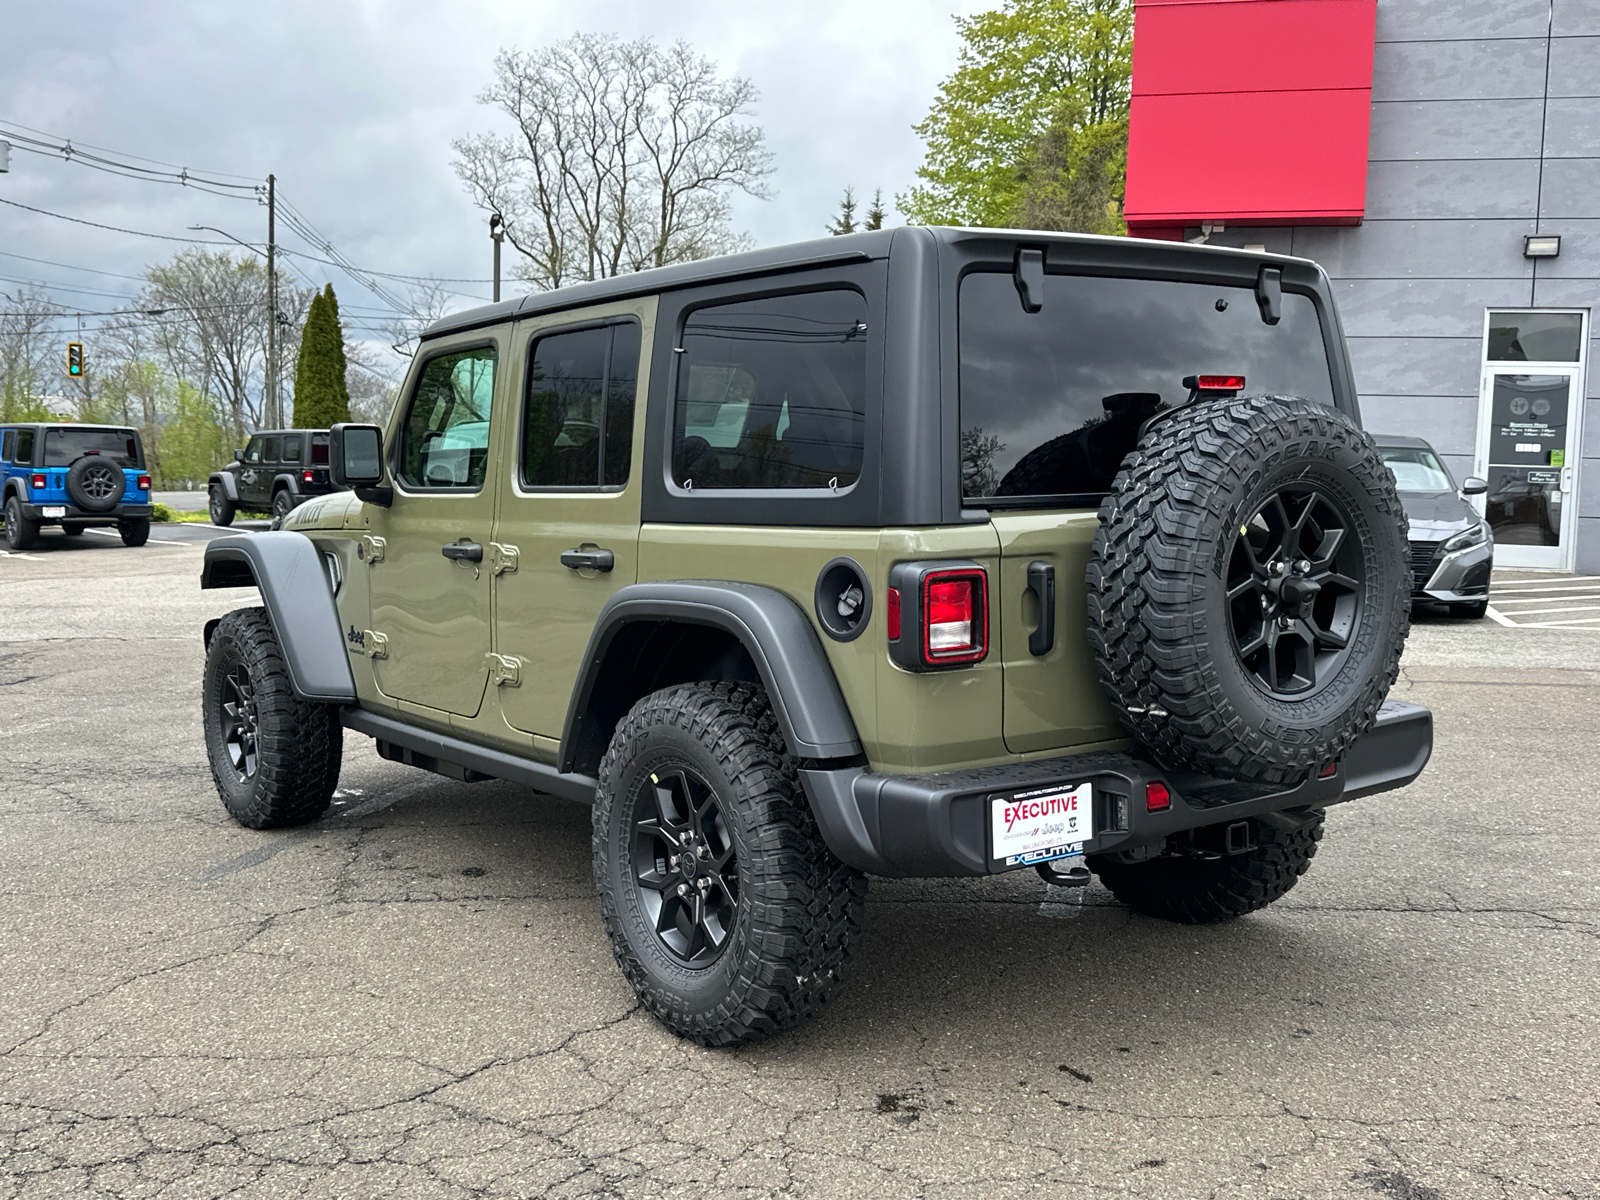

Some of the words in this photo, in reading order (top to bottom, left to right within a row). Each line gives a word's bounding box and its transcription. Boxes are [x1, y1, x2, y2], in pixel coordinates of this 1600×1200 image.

[347, 624, 365, 648] Jeep
[1004, 796, 1078, 833] EXECUTIVE
[1041, 822, 1065, 836] Jeep
[1006, 842, 1083, 866] EXECUTIVE
